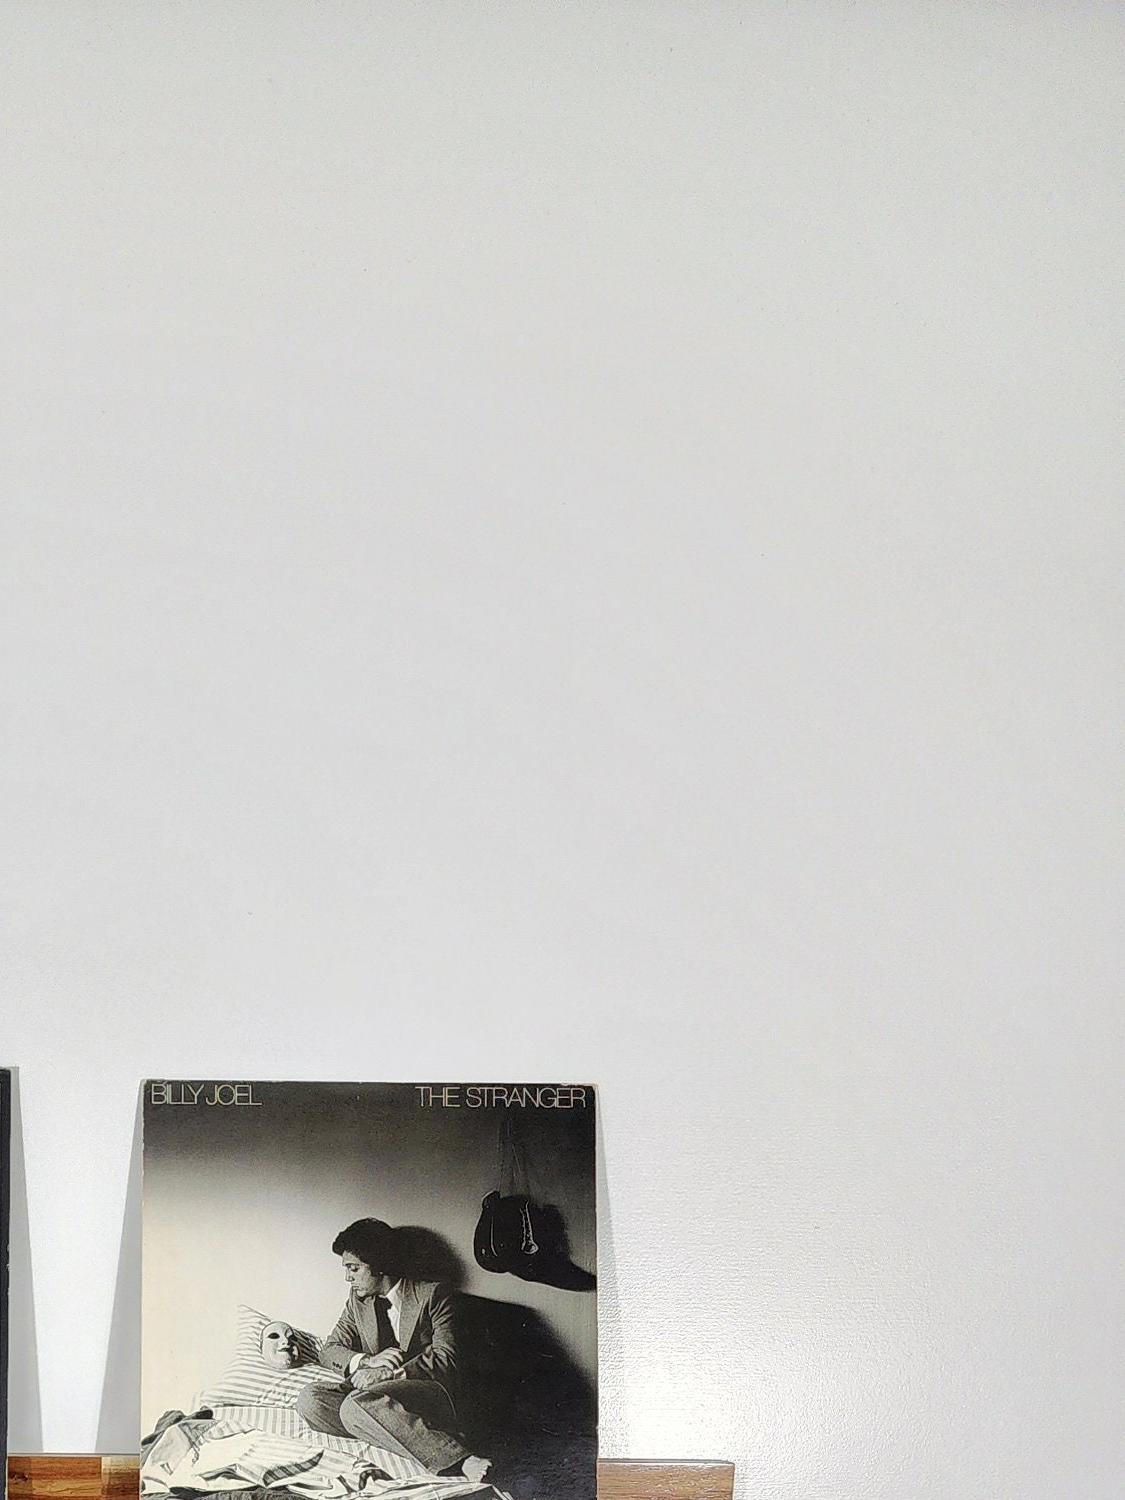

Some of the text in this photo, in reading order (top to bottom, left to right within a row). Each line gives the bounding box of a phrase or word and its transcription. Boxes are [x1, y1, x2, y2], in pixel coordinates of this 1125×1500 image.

[152, 1083, 263, 1106] BILLY JOEL
[415, 1087, 585, 1107] THE STRANGER
